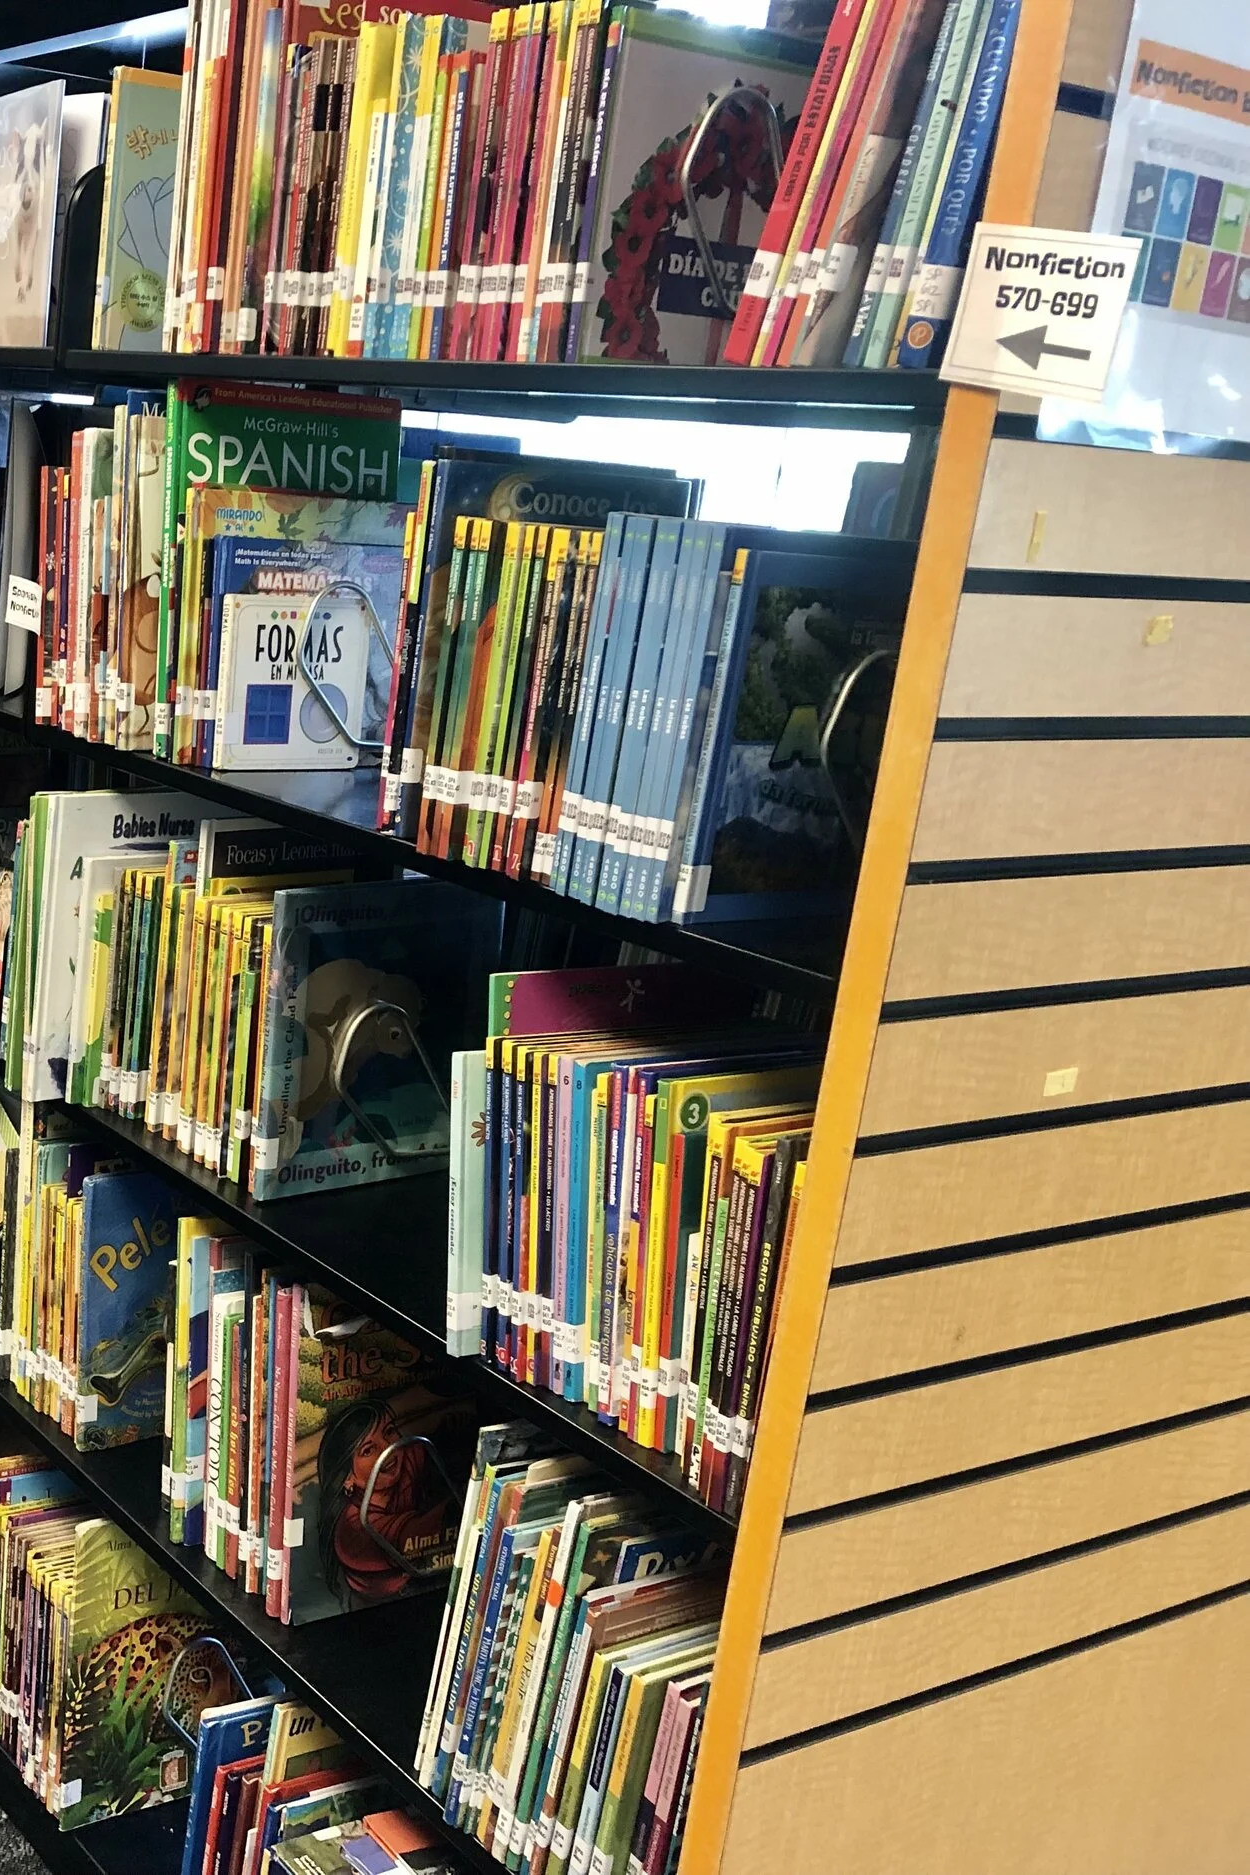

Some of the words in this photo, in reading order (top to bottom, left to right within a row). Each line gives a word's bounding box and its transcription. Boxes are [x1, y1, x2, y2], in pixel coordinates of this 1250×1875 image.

[602, 88, 608, 103] DE
[1136, 59, 1238, 105] Nonfiction
[456, 91, 465, 109] DÍA
[454, 113, 462, 129] DE
[597, 104, 606, 131] LOS
[449, 130, 460, 173] MARTIN
[591, 133, 602, 177] CAÍDOS
[444, 175, 455, 216] LUTHER
[440, 218, 451, 248] KING,
[668, 252, 706, 277] DÍA
[714, 262, 737, 283] DE
[985, 246, 1125, 280] Nonfiction
[995, 284, 1099, 319] 570-699
[214, 387, 236, 399] From
[358, 402, 394, 414] Publisher
[243, 415, 340, 439] McGraw-Hill's
[186, 432, 389, 497] SPANISH
[511, 482, 610, 517] Conoce
[216, 508, 263, 522] MIRANDO
[235, 557, 251, 565] Math
[12, 585, 38, 602] Spanish
[255, 624, 344, 663] FORMAS
[271, 665, 281, 681] EN
[286, 665, 297, 681] MI
[112, 814, 156, 839] Babies
[158, 812, 195, 836] Nurse
[226, 845, 266, 866] Focas
[269, 848, 278, 866] y
[281, 841, 328, 861] Leones
[285, 1002, 296, 1044] Cloud
[285, 1049, 293, 1073] the
[563, 1075, 569, 1086] 6
[576, 1079, 582, 1090] 8
[278, 1074, 294, 1135] Unveiling
[688, 1103, 700, 1125] 3
[277, 1159, 367, 1185] Olinguito,
[611, 1163, 617, 1173] tu
[635, 1169, 641, 1179] tu
[449, 1176, 457, 1206] ¡Estoy
[609, 1174, 617, 1206] mundo
[448, 1208, 456, 1256] creciendo!
[89, 1200, 172, 1293] Pelé
[605, 1233, 614, 1287] vehículos
[698, 1274, 707, 1287] LAS
[758, 1242, 771, 1294] ESCRITO
[604, 1289, 611, 1304] de
[732, 1305, 740, 1314] LA
[625, 1302, 635, 1336] granja
[721, 1310, 731, 1336] GRANOS
[730, 1315, 739, 1336] CARNE
[728, 1340, 736, 1349] EL
[749, 1306, 763, 1362] DIBUJADO
[320, 1340, 384, 1385] the
[716, 1336, 727, 1372] INTEGRALES
[724, 1349, 734, 1377] PESCADO
[206, 1377, 223, 1426] CON
[404, 1531, 440, 1552] Alma
[114, 1583, 157, 1610] DEL
[470, 1572, 482, 1598] SIDE
[462, 1614, 473, 1638] SIDE
[446, 1680, 459, 1711] LADO
[288, 1714, 316, 1738] un
